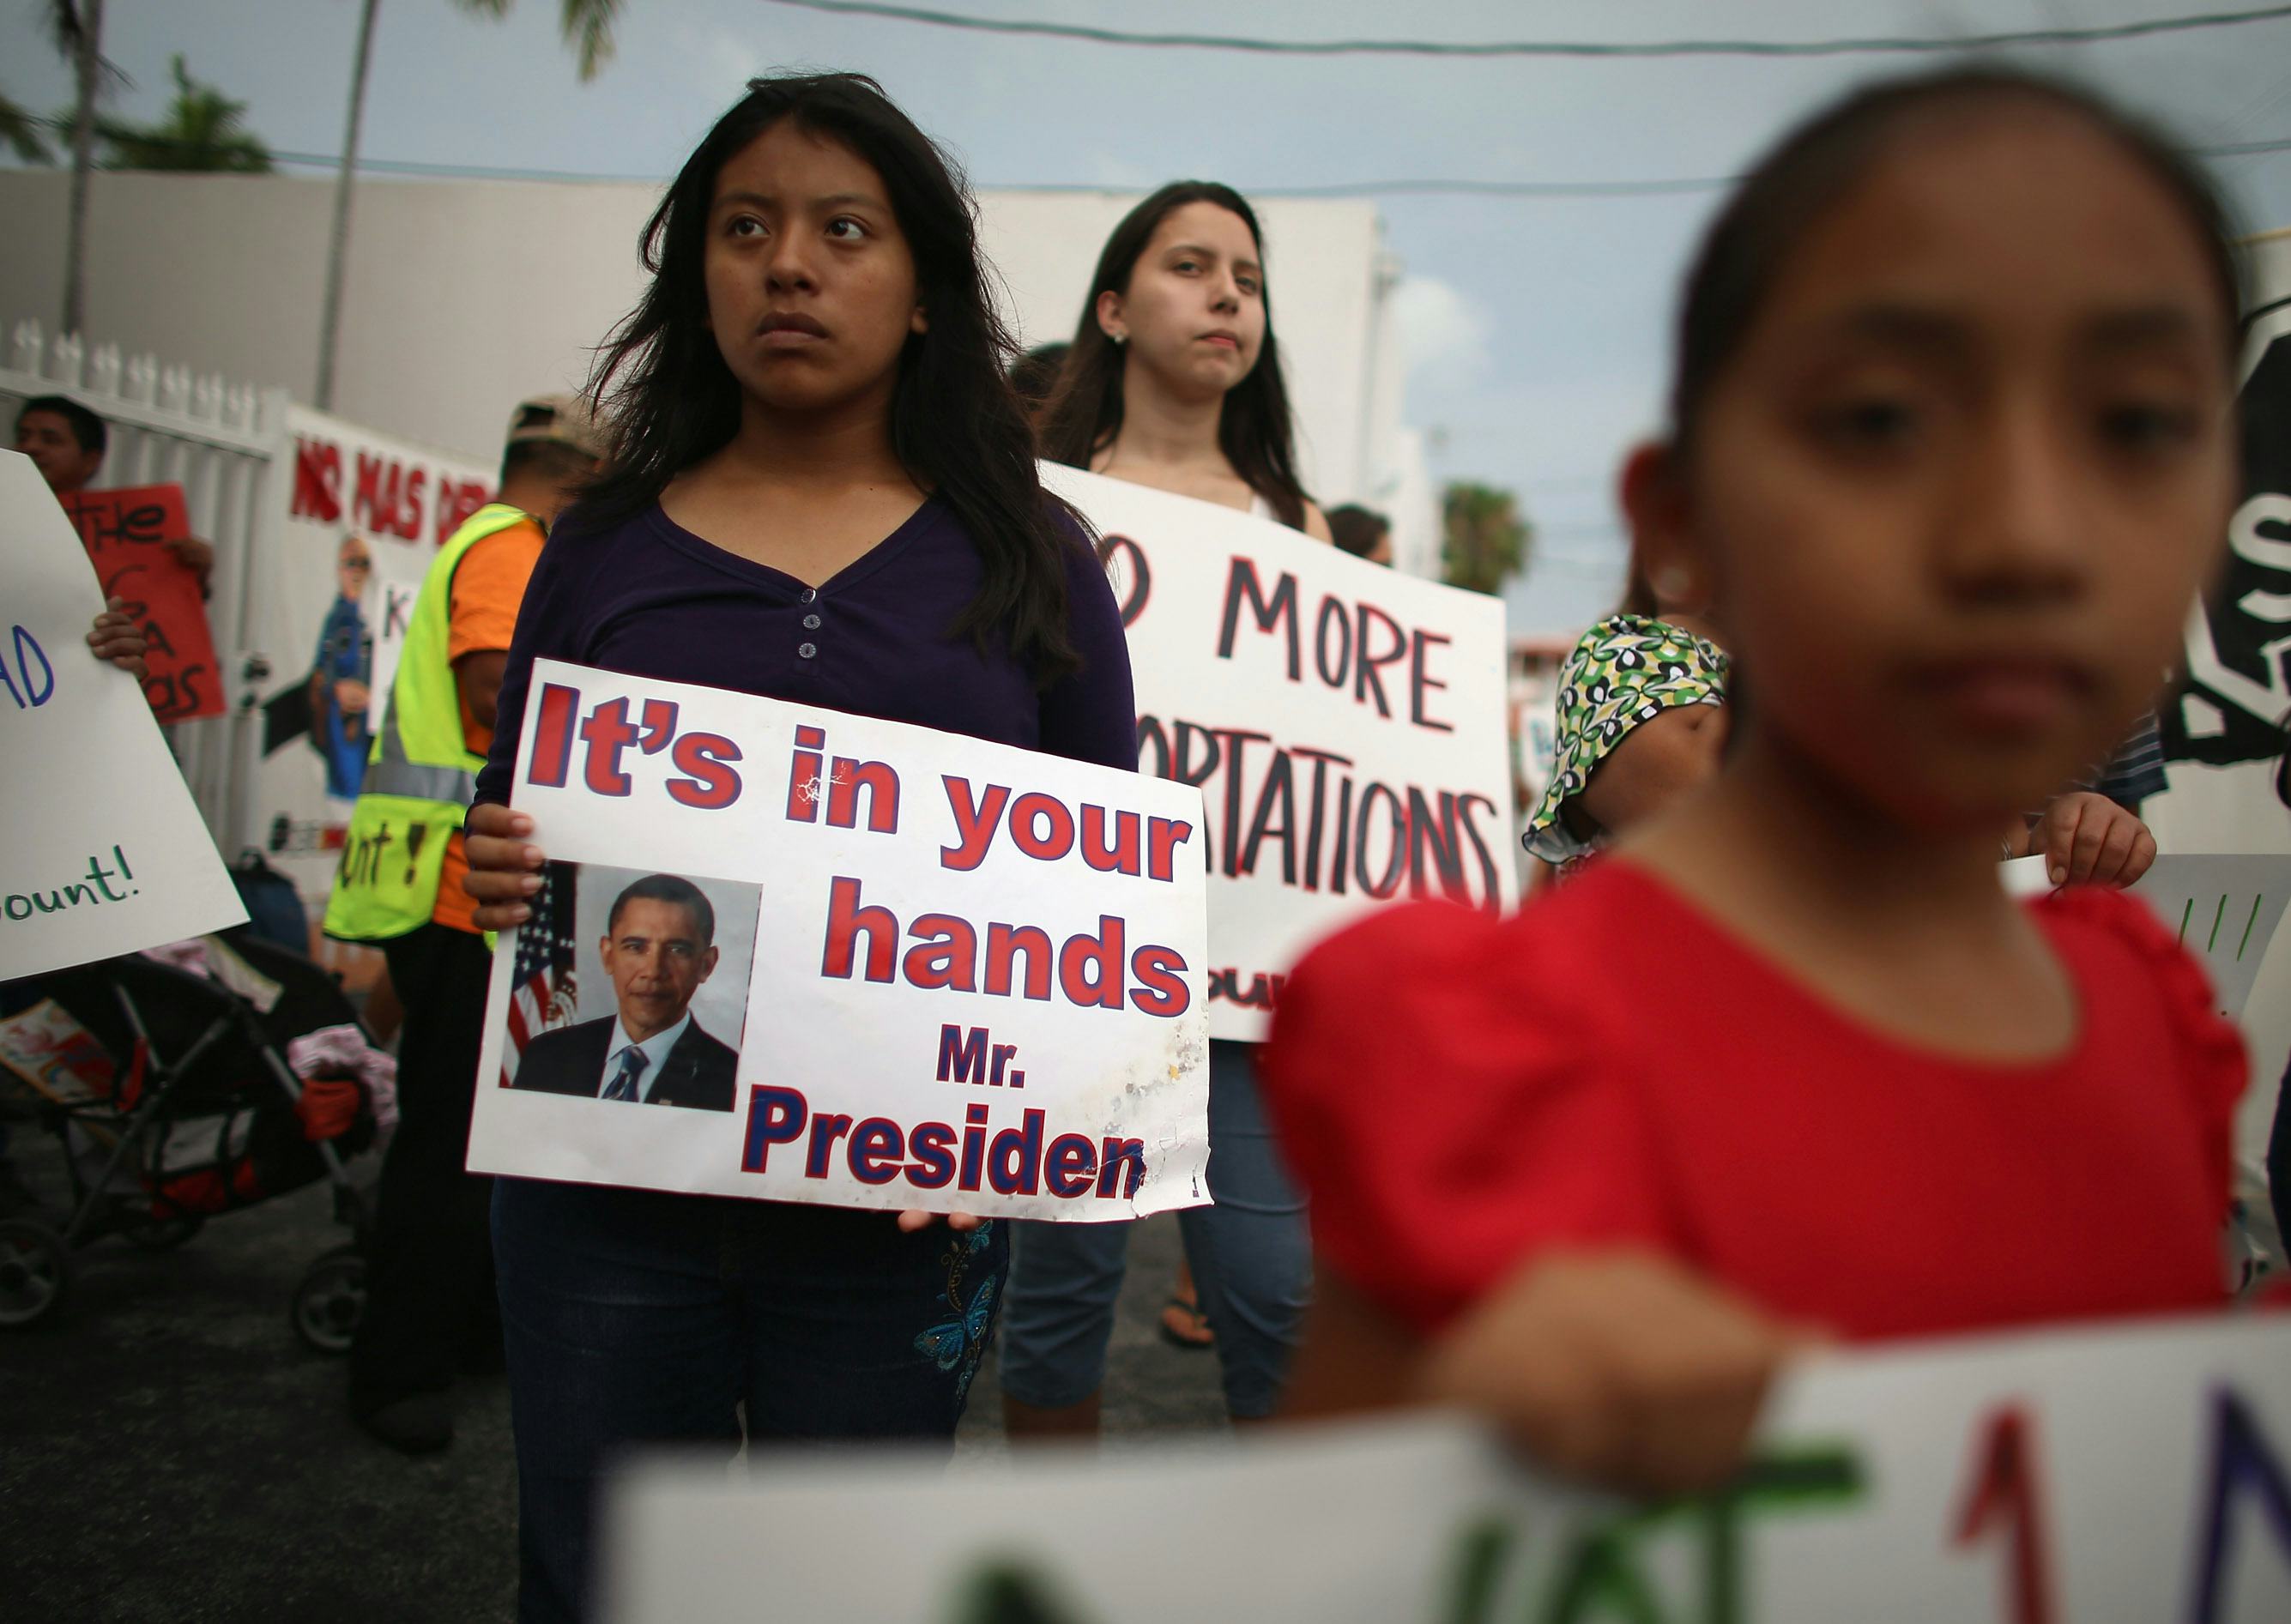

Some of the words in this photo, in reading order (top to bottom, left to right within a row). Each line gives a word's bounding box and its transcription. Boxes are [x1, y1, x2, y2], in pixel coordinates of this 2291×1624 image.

[352, 448, 426, 543] MAS
[1094, 532, 1152, 631] O
[1214, 554, 1456, 734] MORE
[526, 682, 744, 811] It's
[785, 724, 901, 834] in
[940, 774, 1194, 884] your
[0, 844, 140, 921] ount!
[820, 876, 1192, 1018] hands
[935, 1023, 1026, 1090] Mr.
[740, 1083, 1147, 1200] Presiden
